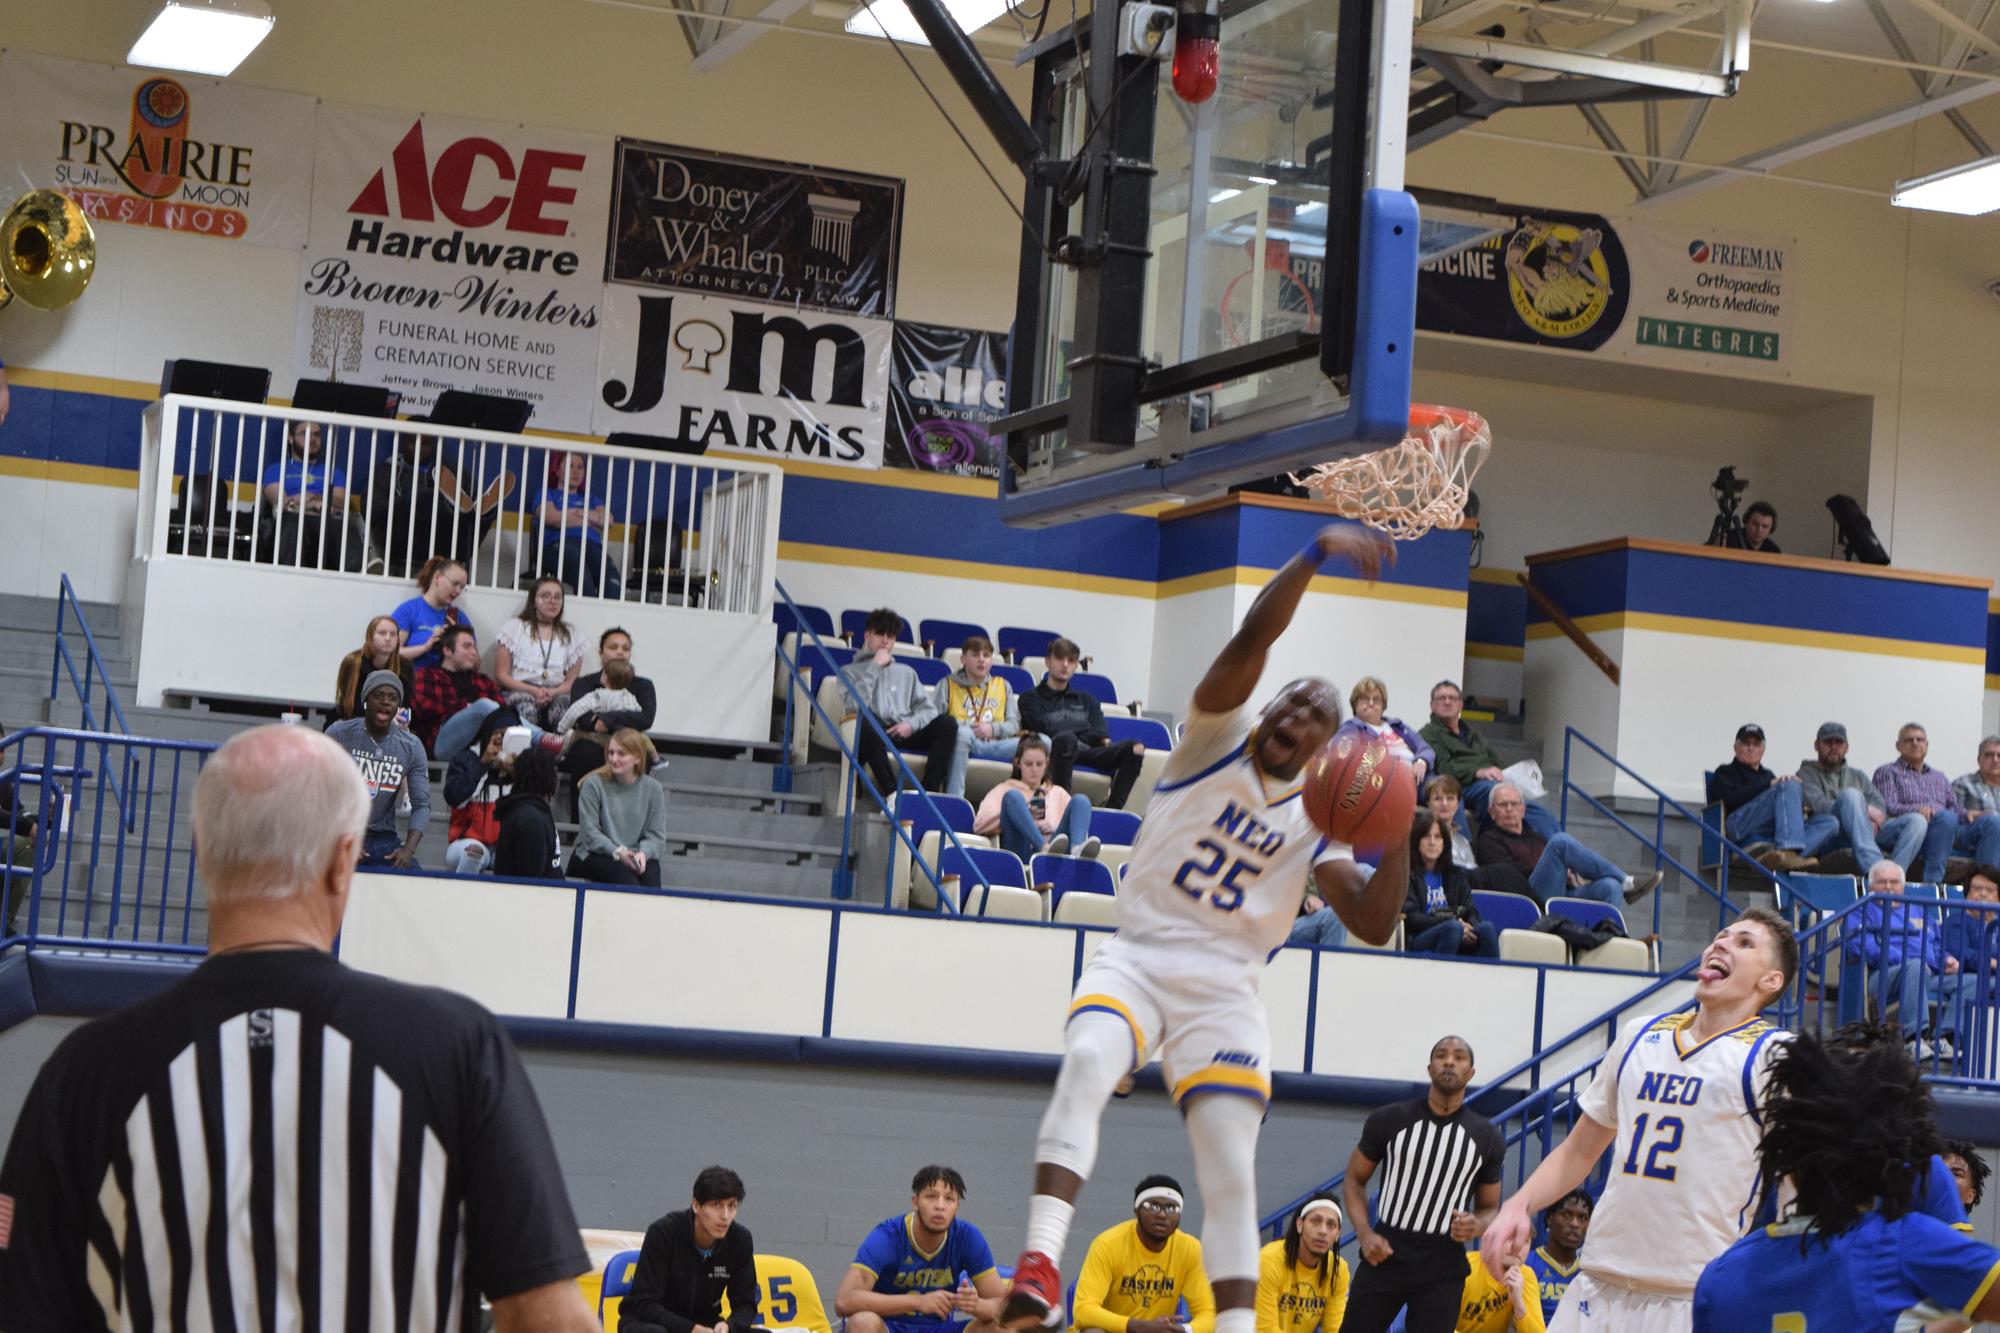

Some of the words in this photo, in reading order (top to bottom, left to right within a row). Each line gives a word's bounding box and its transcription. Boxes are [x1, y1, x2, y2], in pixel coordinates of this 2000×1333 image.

[55, 165, 99, 185] SUN
[98, 176, 118, 185] and
[57, 119, 253, 199] PRAIRIE
[347, 117, 586, 236] ACE
[183, 183, 249, 208] MOON
[652, 157, 759, 224] Doney
[711, 210, 730, 232] &
[346, 219, 579, 276] Hardware
[652, 216, 784, 277] Whalen
[1711, 242, 1783, 271] FREEMAN
[641, 266, 768, 293] ATTORNEYS
[781, 286, 804, 299] AT
[817, 291, 859, 306] LAW
[804, 264, 847, 285] PLLC
[1696, 272, 1780, 296] Orthopaedics
[1666, 287, 1678, 303] &
[1682, 289, 1719, 309] Sports
[1722, 295, 1779, 317] Medicine
[378, 320, 459, 344] FUNERAL
[464, 329, 520, 351] HOME
[525, 342, 556, 356] AND
[1642, 321, 1773, 357] INTEGRIS
[374, 345, 481, 373] CREMATION
[486, 358, 557, 381] SERVICE
[381, 375, 418, 388] Jeffery
[423, 378, 455, 392] Brown
[471, 384, 503, 395] Jason
[507, 387, 544, 401] Winters
[679, 405, 865, 461] FARMS
[352, 748, 398, 763] SACRANTO
[353, 757, 403, 786] INGS
[1212, 799, 1287, 857] NEO
[1173, 837, 1262, 913] 25
[1636, 1070, 1704, 1106] NEO
[1622, 1111, 1685, 1183] 12
